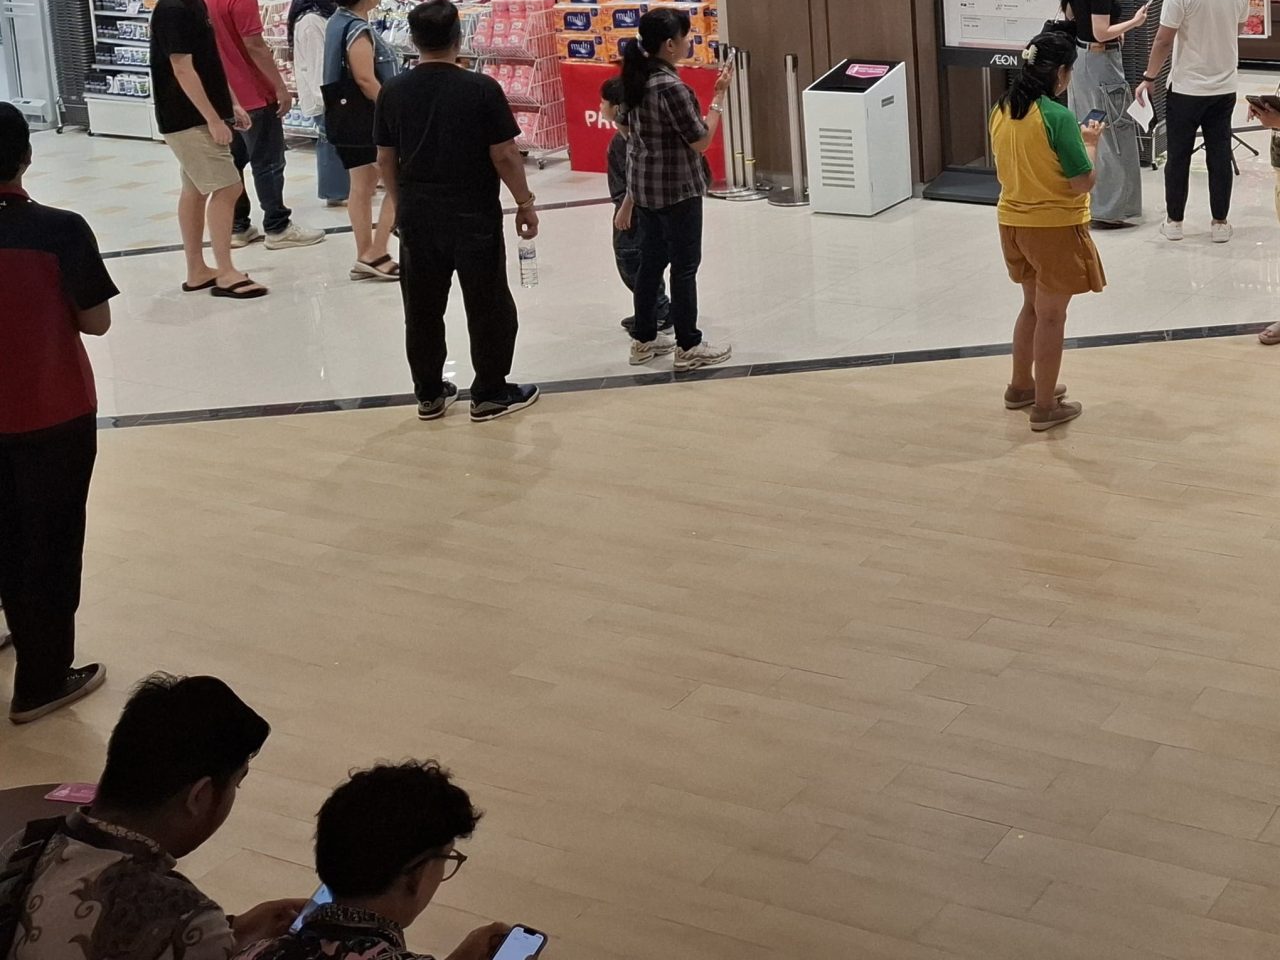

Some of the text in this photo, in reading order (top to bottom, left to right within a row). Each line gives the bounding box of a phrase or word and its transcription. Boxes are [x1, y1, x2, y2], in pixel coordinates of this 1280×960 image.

[567, 11, 587, 23] multi
[615, 10, 636, 22] multi
[570, 39, 590, 50] multi
